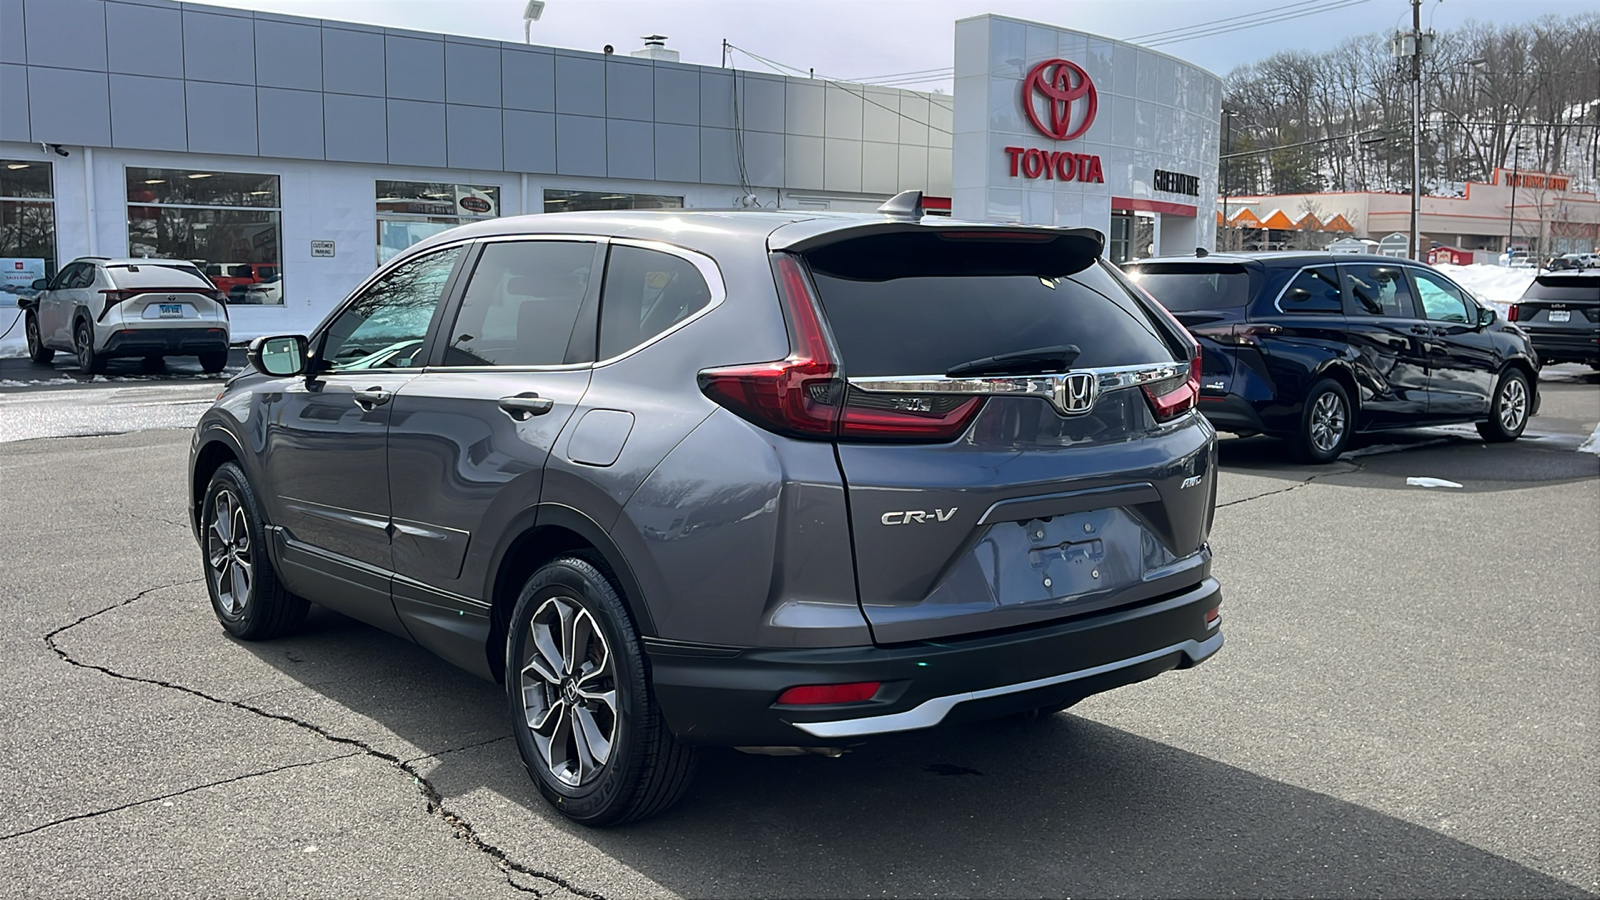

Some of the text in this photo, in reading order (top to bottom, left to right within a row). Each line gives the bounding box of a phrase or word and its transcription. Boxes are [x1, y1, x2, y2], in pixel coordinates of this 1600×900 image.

[1005, 147, 1105, 184] TOYOTA
[1153, 168, 1200, 197] GREENTREE
[1523, 174, 1545, 190] HOME
[1546, 177, 1568, 191] DEPOT
[1180, 474, 1202, 490] AWD
[881, 506, 959, 526] CR-V
